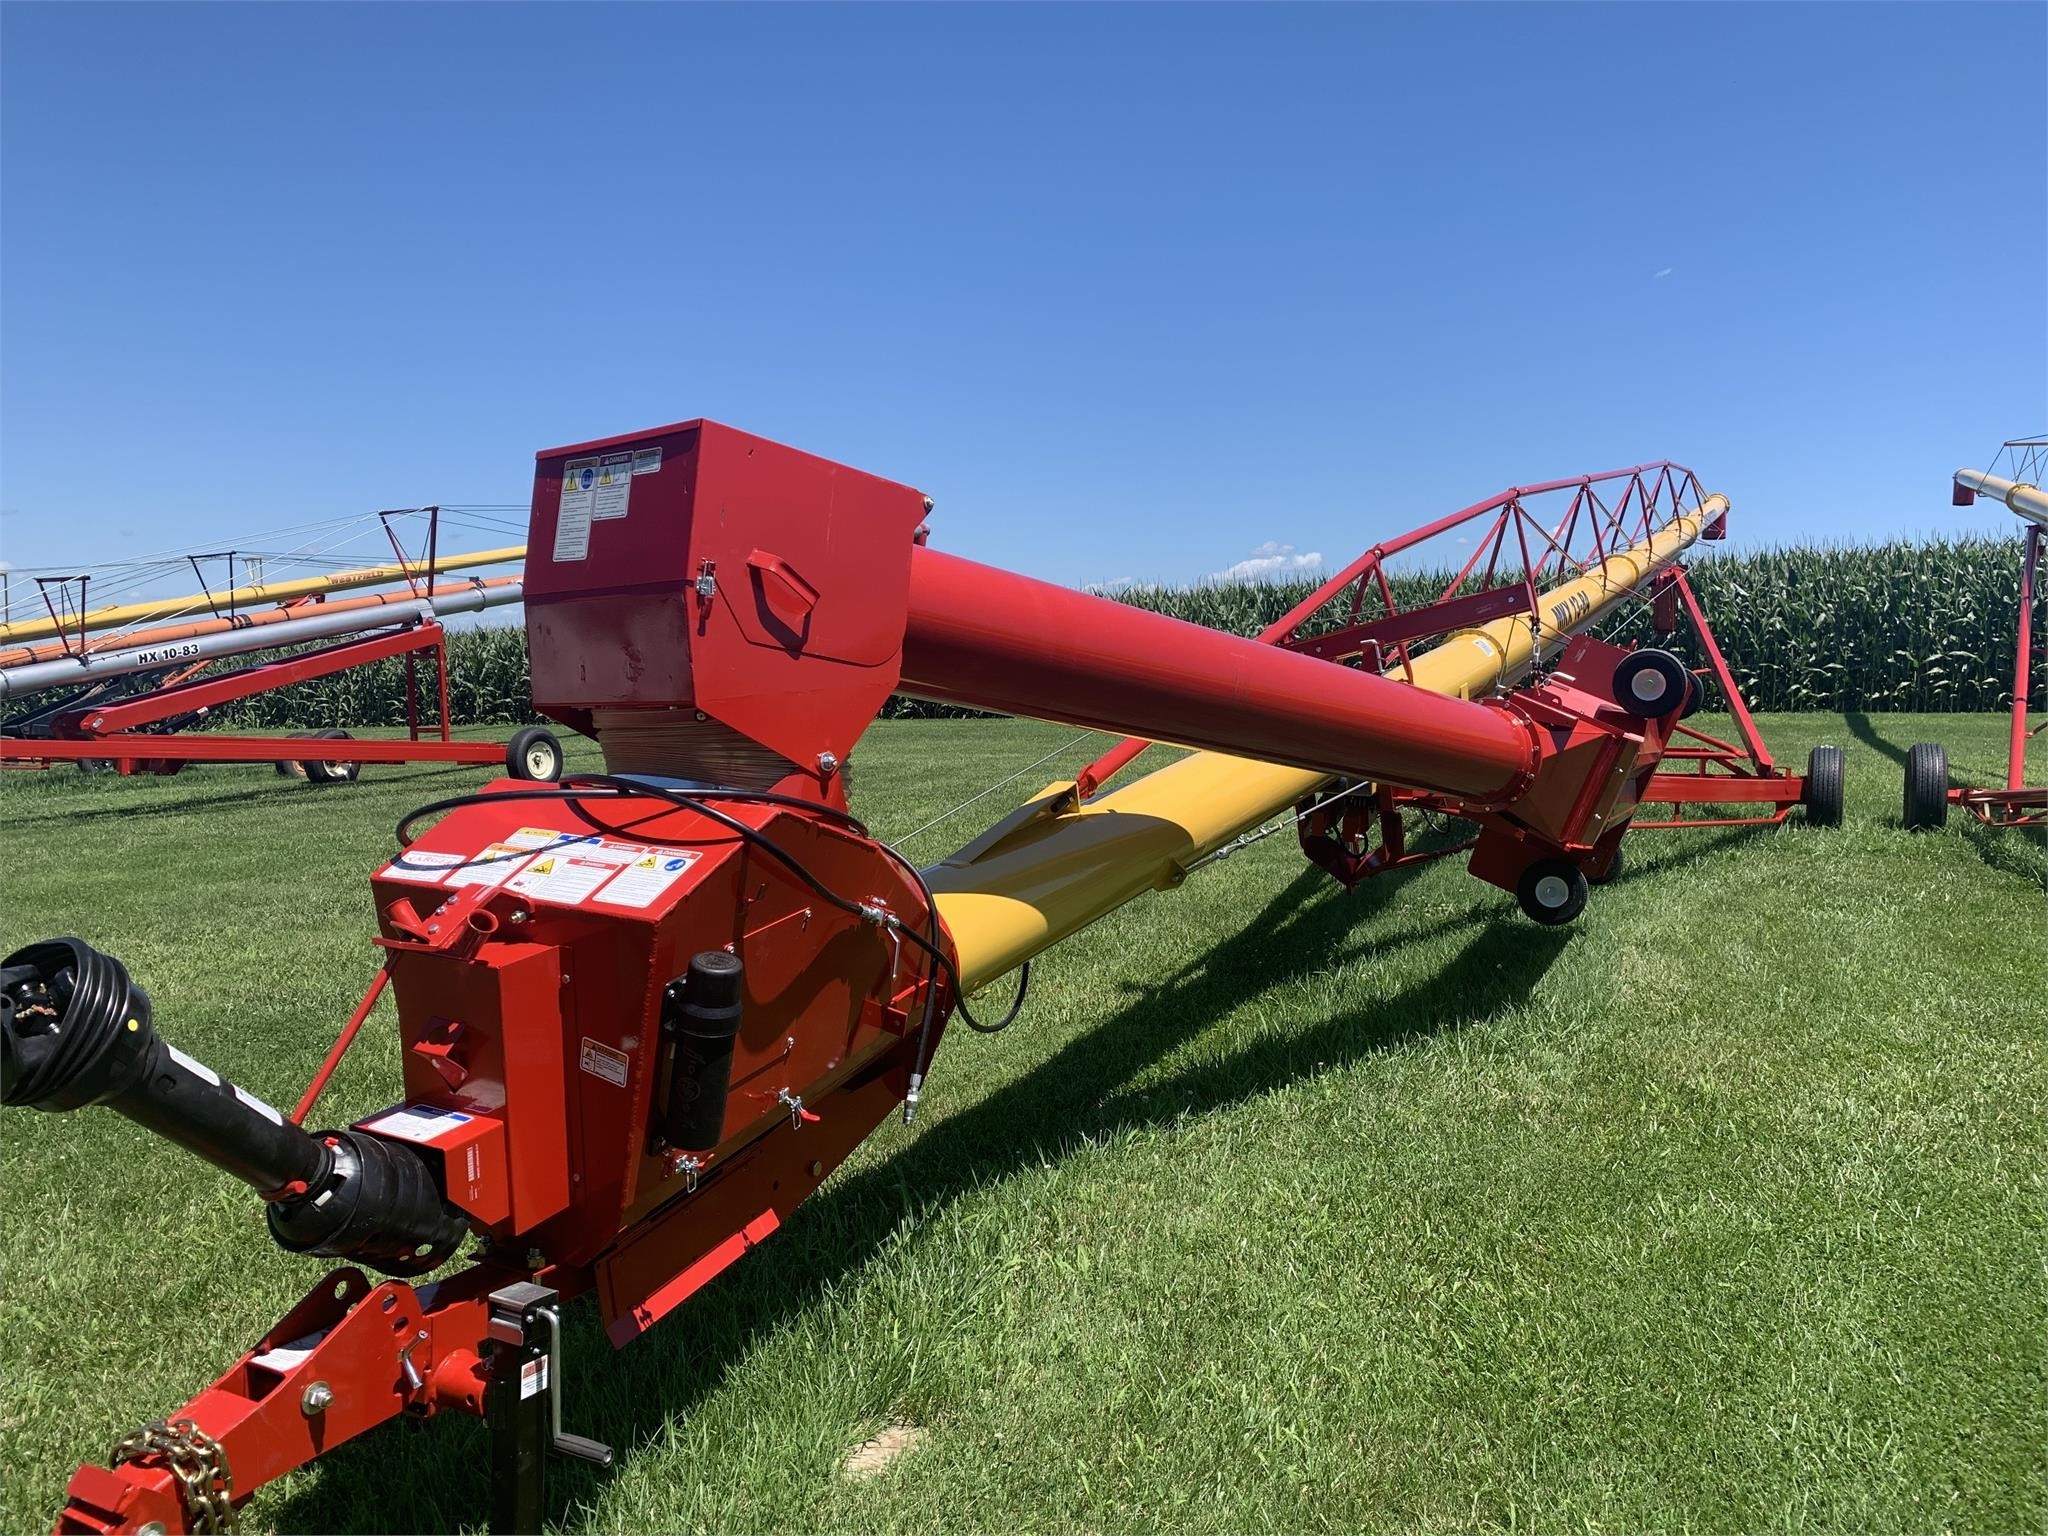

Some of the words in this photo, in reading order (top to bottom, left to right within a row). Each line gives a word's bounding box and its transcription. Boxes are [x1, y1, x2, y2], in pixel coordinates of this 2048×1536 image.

[329, 570, 384, 584] WESTFIELD
[138, 651, 158, 664] HX
[162, 644, 199, 659] 10-83
